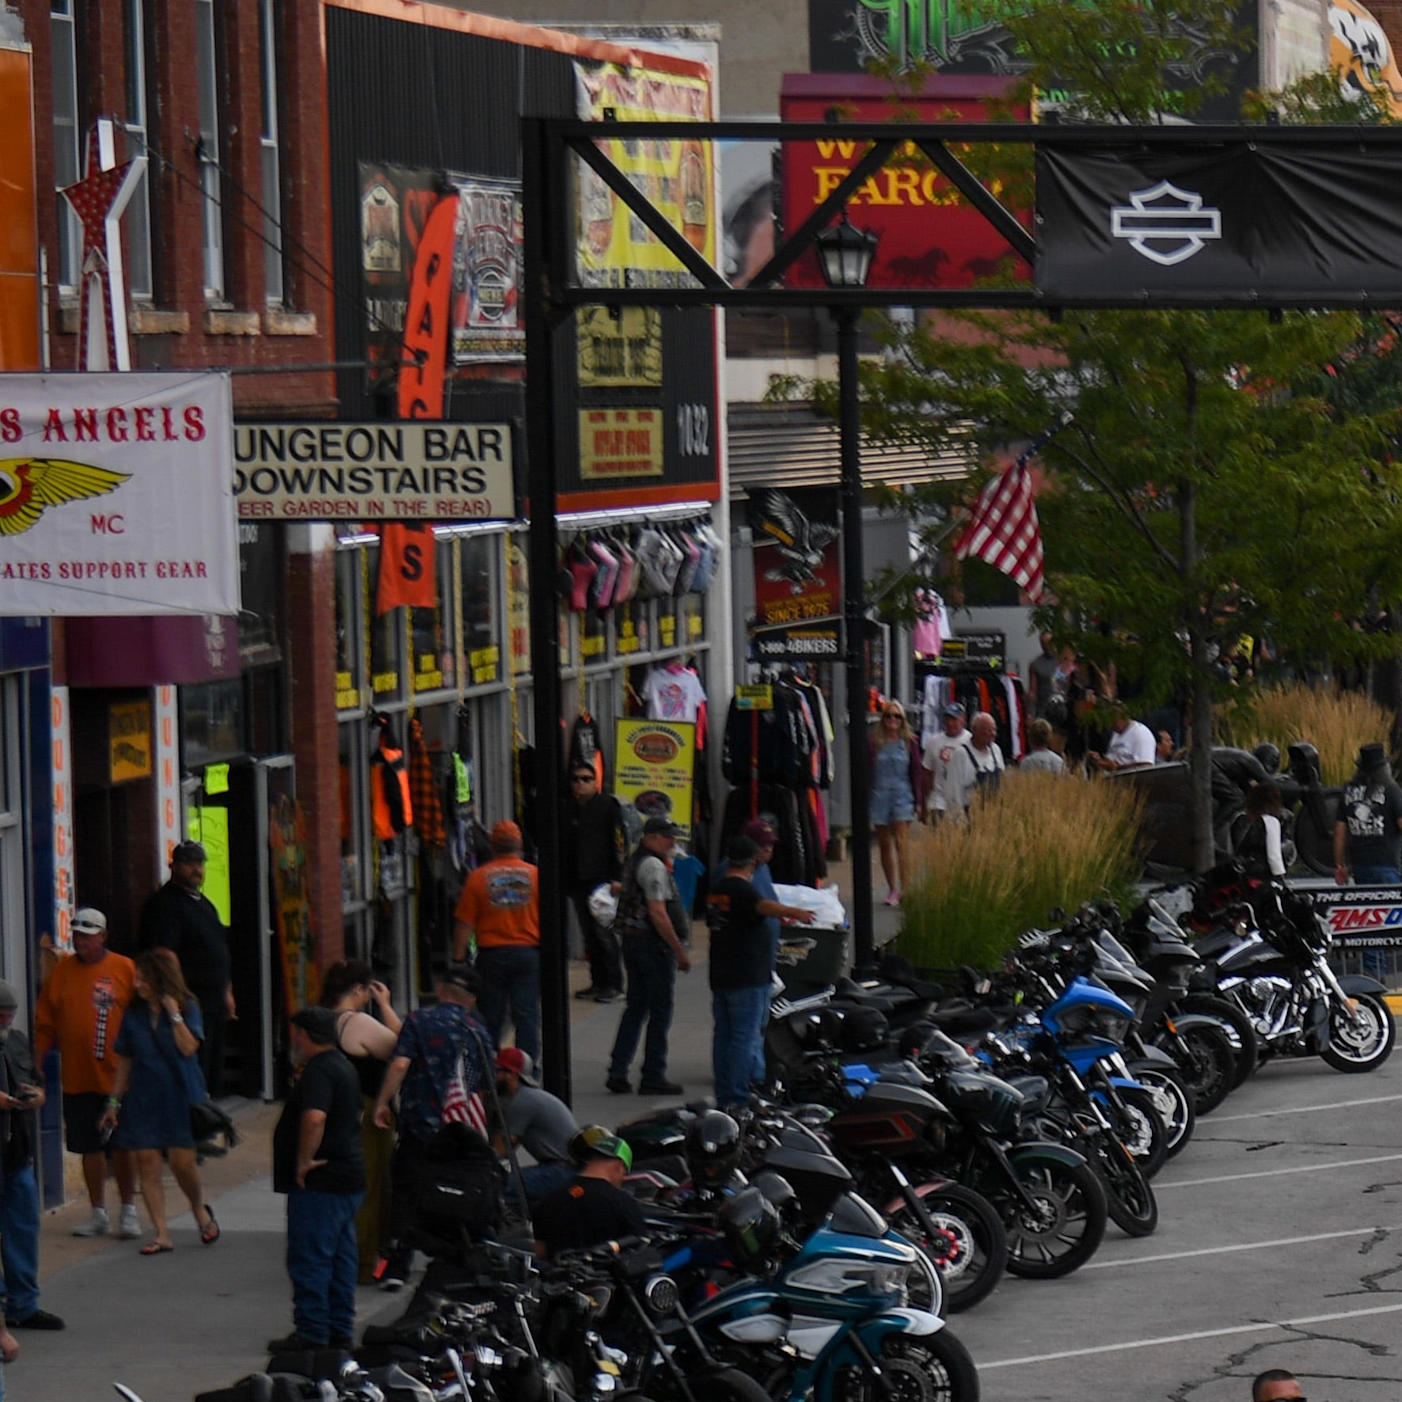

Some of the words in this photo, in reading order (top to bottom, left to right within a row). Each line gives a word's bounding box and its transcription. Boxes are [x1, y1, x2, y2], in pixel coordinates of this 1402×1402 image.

[42, 405, 207, 443] ANGELS
[423, 427, 504, 462] BAR
[282, 501, 360, 516] GARDEN
[366, 501, 385, 516] IN
[392, 501, 429, 516] THE
[435, 501, 492, 517] REAR)
[90, 514, 125, 534] MC
[59, 561, 149, 579] SUPPORT
[155, 561, 208, 579] GEAR
[1316, 892, 1341, 902] THE
[1344, 890, 1402, 901] OFFICIAL
